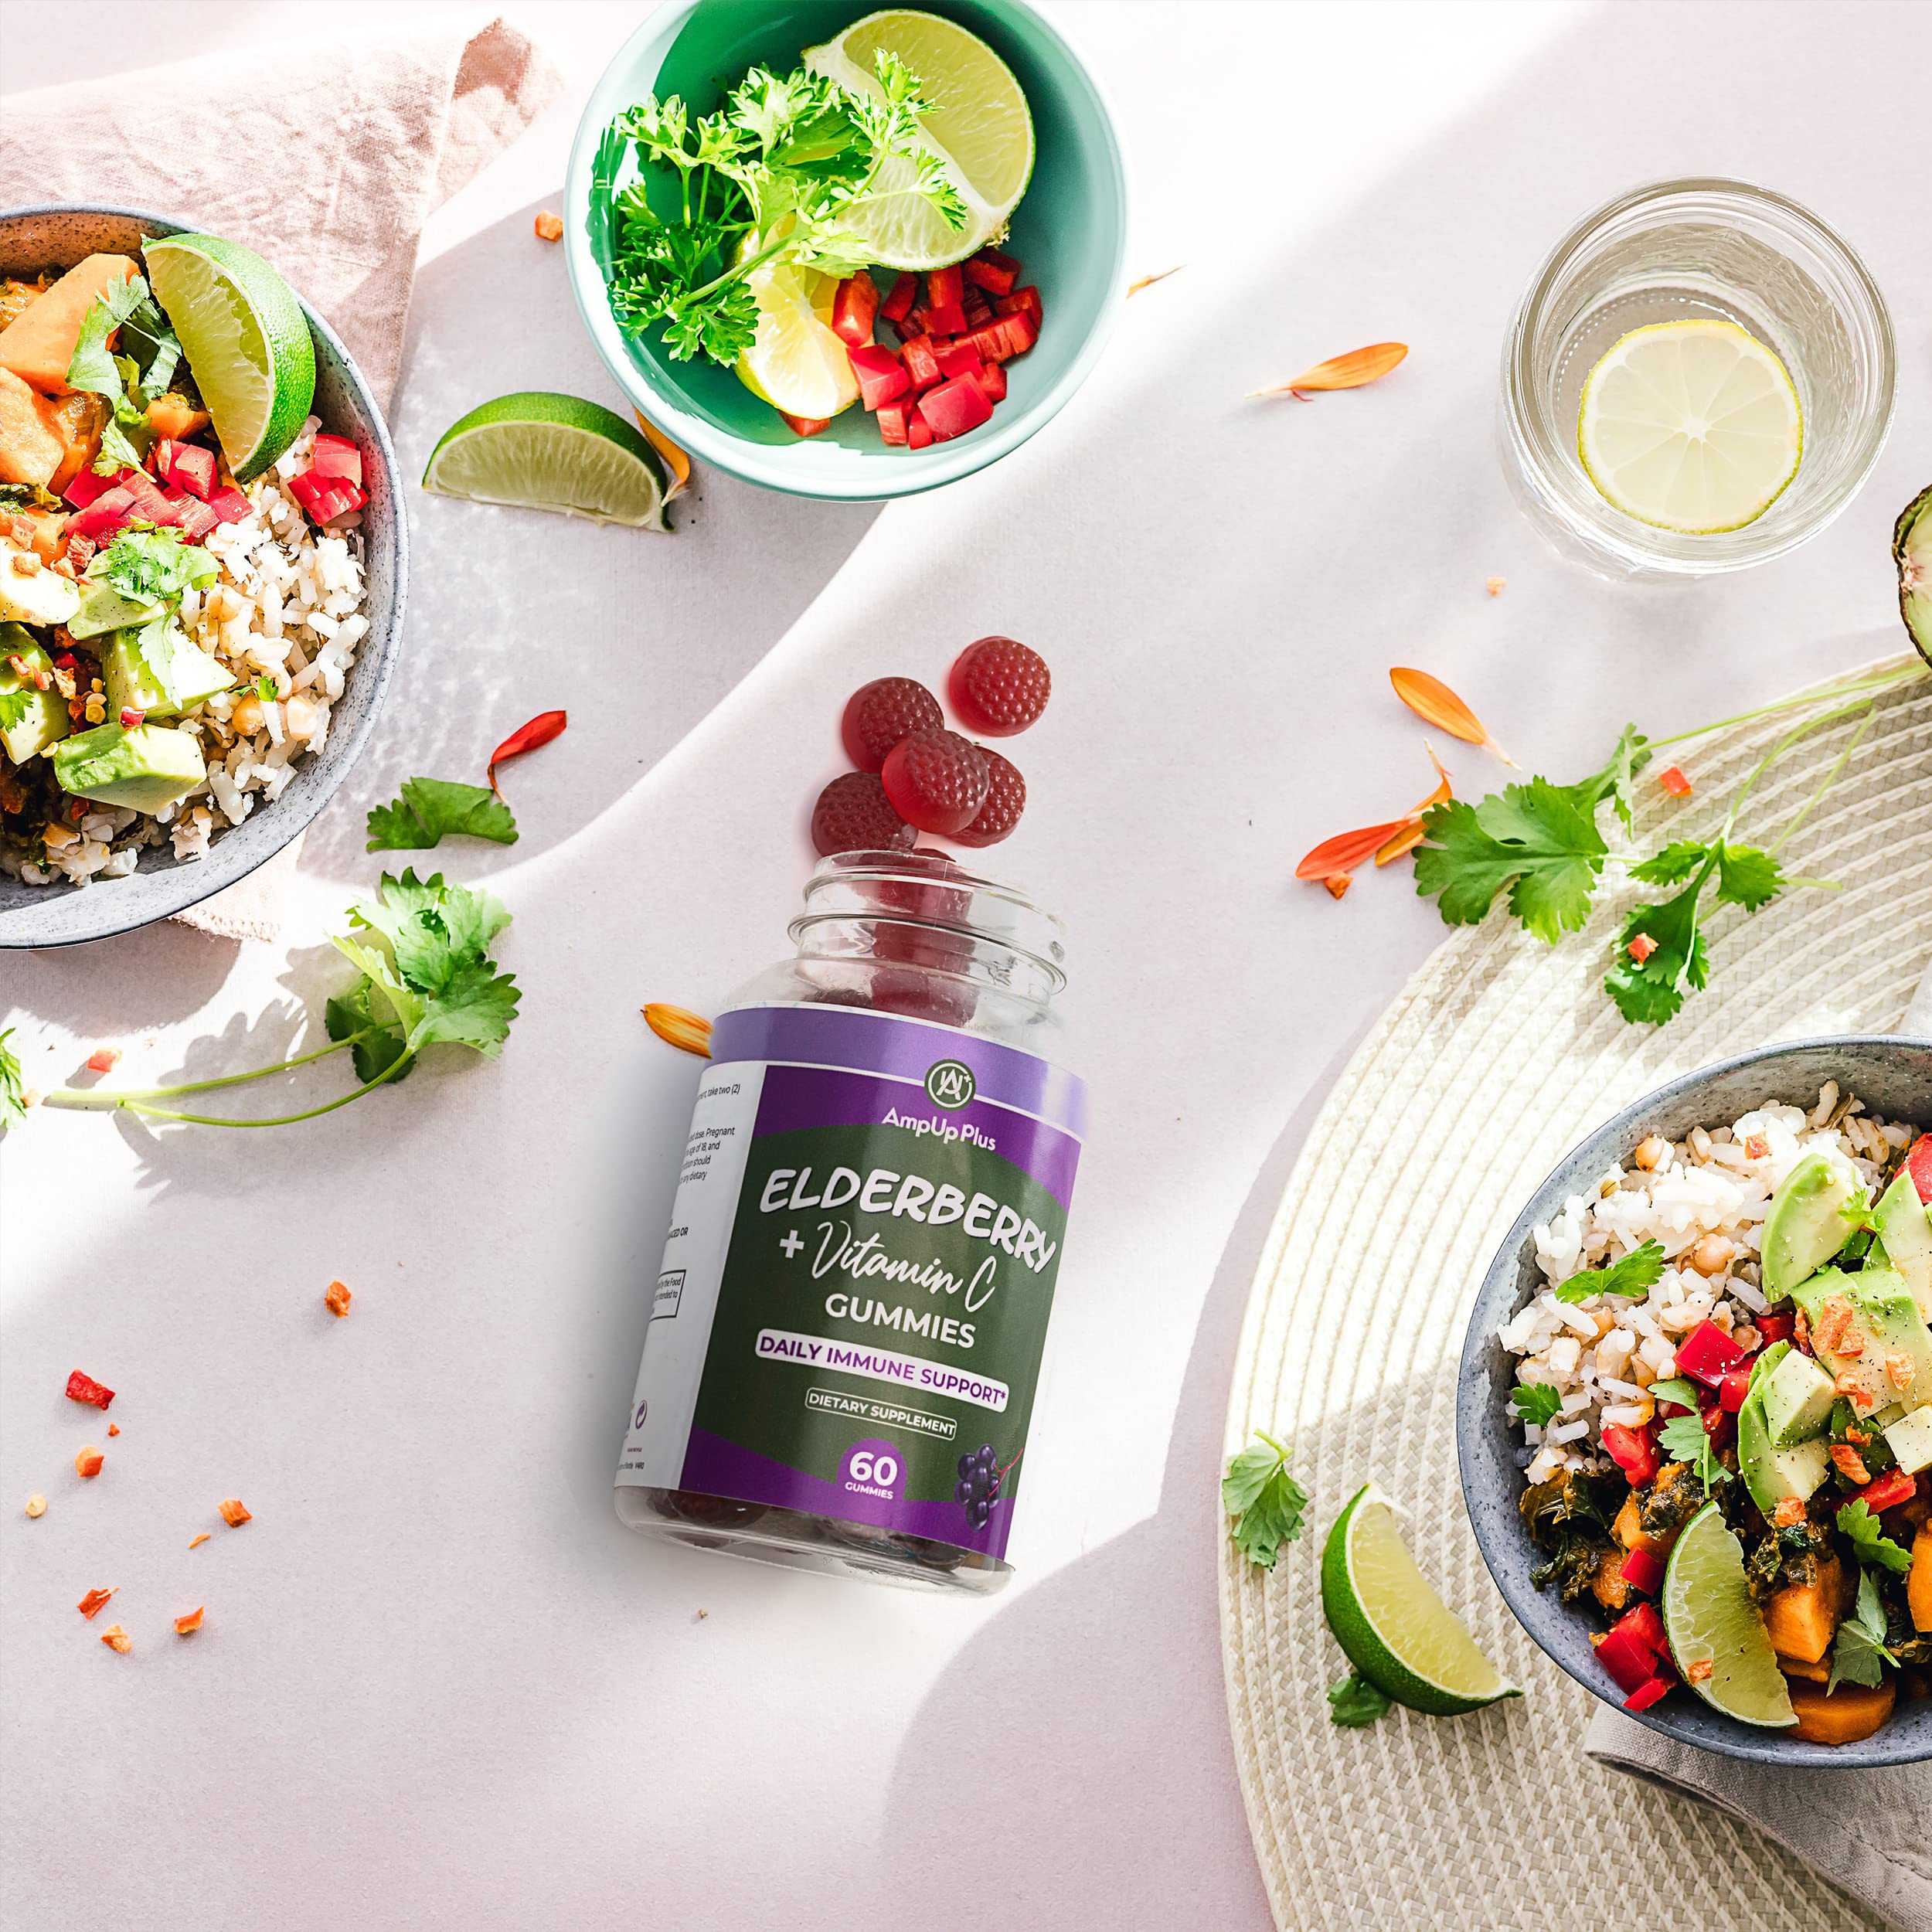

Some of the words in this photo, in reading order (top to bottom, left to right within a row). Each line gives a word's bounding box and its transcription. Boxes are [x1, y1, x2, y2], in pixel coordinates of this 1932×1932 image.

[707, 1087, 718, 1097] take
[719, 1086, 730, 1094] two
[731, 1083, 740, 1094] (2)
[706, 1127, 736, 1138] Pregnant
[960, 1124, 996, 1151] Plus
[708, 1141, 720, 1151] and
[693, 1155, 711, 1166] should
[689, 1171, 708, 1181] dietary
[760, 1167, 1056, 1274] ELDERBERRY
[811, 1220, 964, 1294] Vitamin
[964, 1255, 998, 1312] C
[670, 1277, 682, 1287] Food
[825, 1293, 976, 1349] GUMMIES
[760, 1336, 822, 1360] DAILY
[826, 1347, 916, 1381] IMMUNE
[808, 1393, 869, 1415] DIETARY
[870, 1404, 957, 1436] SUPPLEMENT
[849, 1451, 899, 1487] 60
[845, 1481, 894, 1500] GUMMIES
